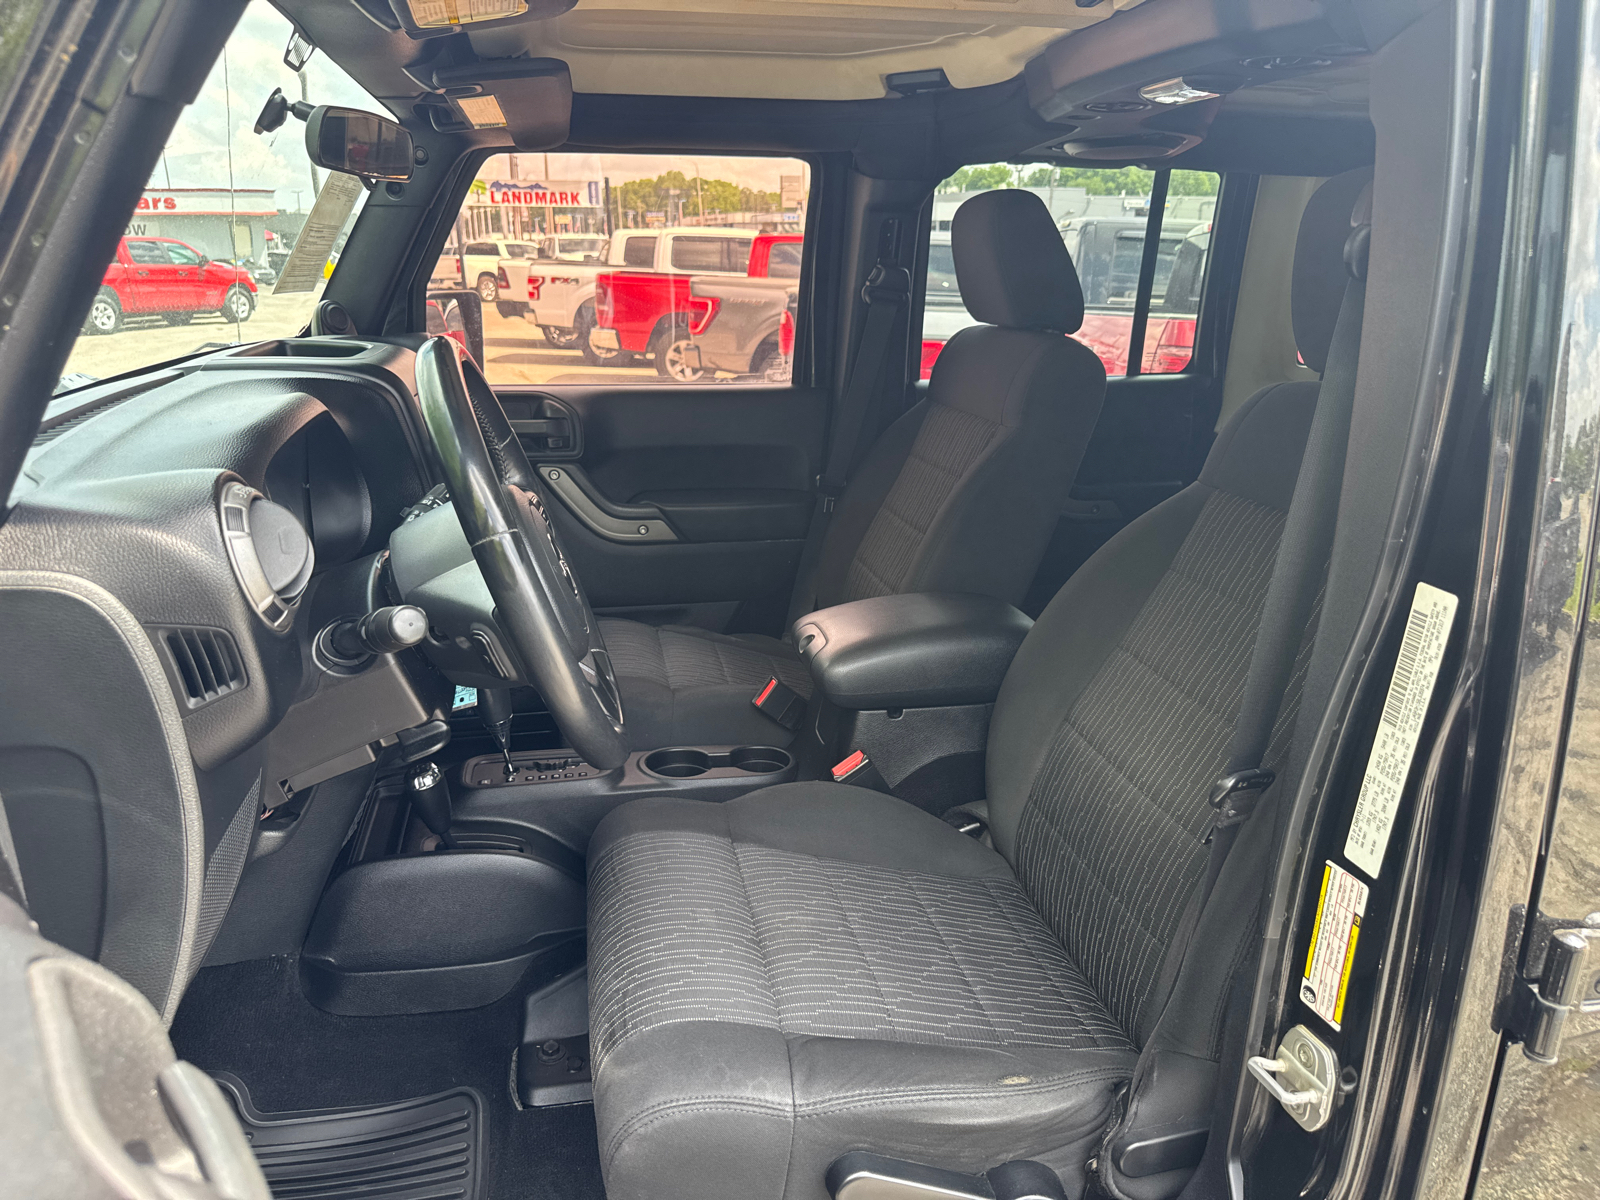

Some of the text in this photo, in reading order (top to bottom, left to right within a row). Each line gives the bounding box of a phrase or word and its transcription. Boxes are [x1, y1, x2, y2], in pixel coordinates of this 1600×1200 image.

[490, 190, 580, 206] LANDMARK
[1352, 800, 1364, 828] CHRYSLER
[1359, 783, 1369, 802] GROUP
